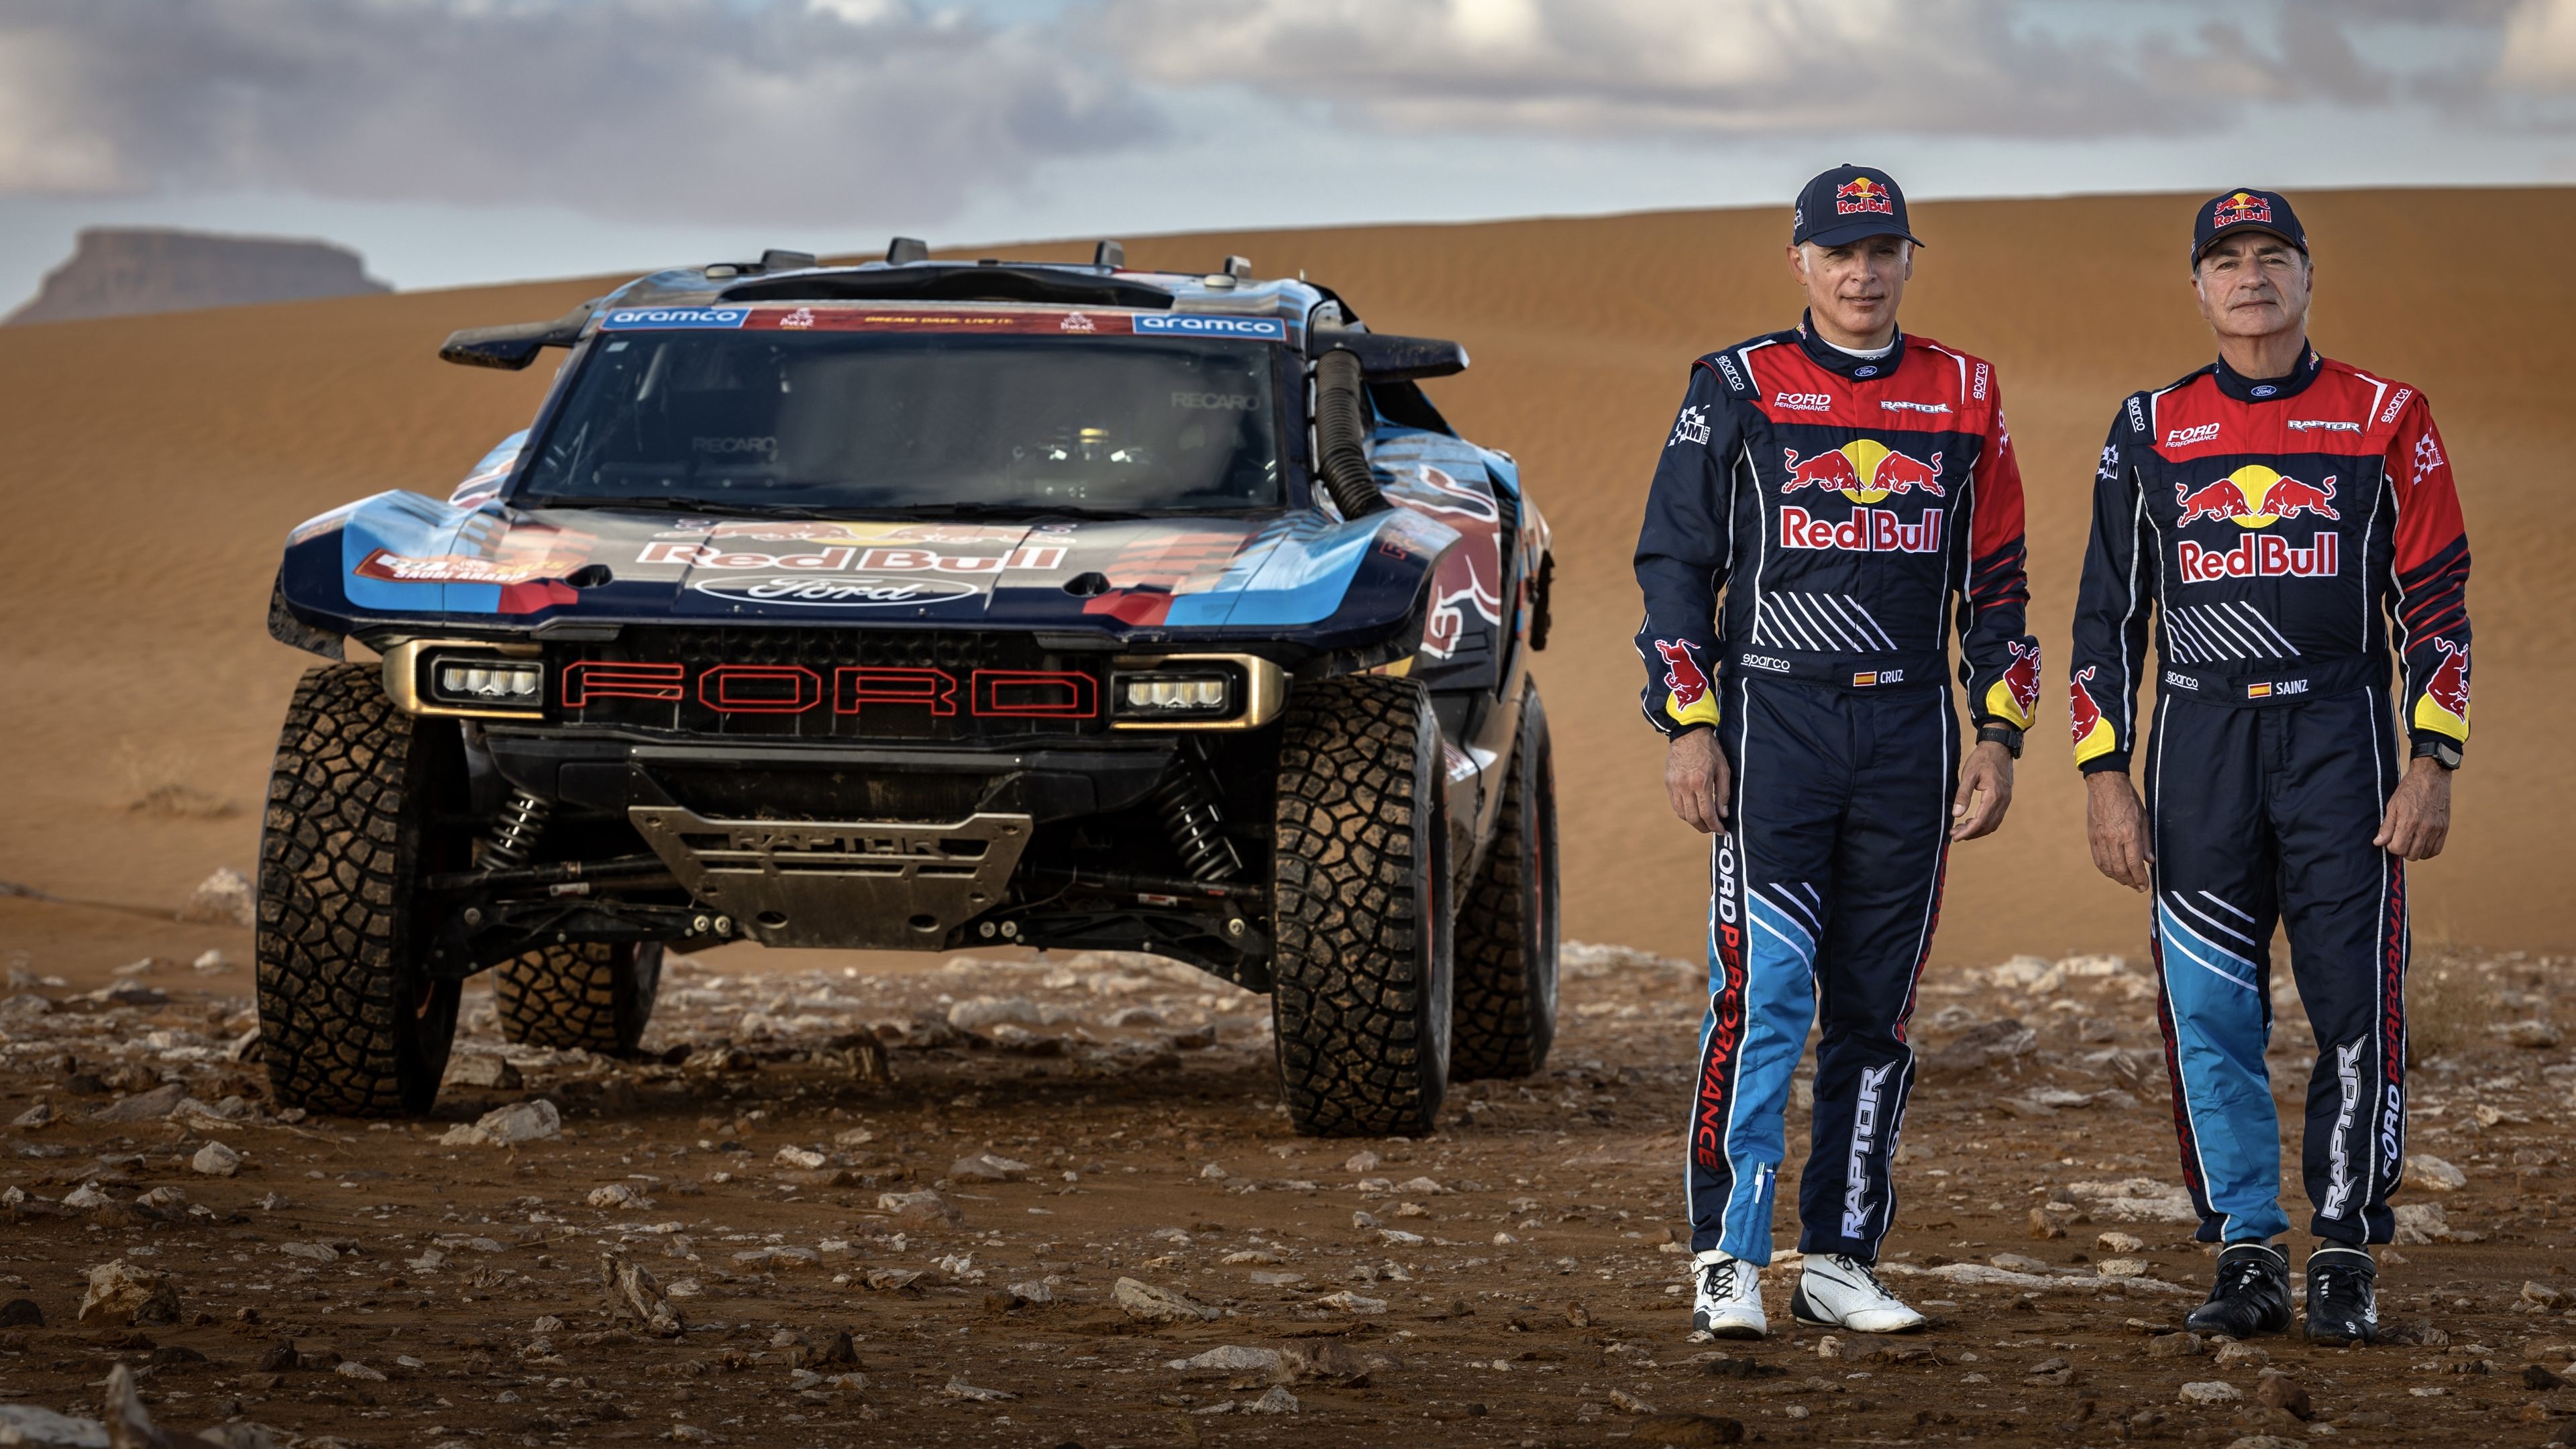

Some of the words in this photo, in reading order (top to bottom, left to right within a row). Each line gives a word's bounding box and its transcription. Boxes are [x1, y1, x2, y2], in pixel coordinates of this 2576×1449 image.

[1837, 197, 1867, 215] Red
[1868, 198, 1893, 215] Bull
[2214, 209, 2242, 229] Red
[2243, 209, 2271, 223] Bull
[613, 310, 737, 323] aramco
[1142, 317, 1276, 333] aramco
[1716, 355, 1744, 391] sparco
[1973, 363, 1988, 400] sparco
[1776, 392, 1831, 406] FORD
[2254, 386, 2274, 396] Ford
[1171, 392, 1260, 411] RECARO
[1774, 401, 1831, 412] PERFORMANCE
[1880, 400, 1953, 413] RAPTOR
[2381, 388, 2412, 424] sparco
[2127, 397, 2145, 433] sparco
[2167, 422, 2220, 442] FORD
[2288, 419, 2363, 437] RAPTOR
[692, 436, 777, 453] RECARO
[2165, 433, 2218, 448] PERFORMANCE
[1780, 505, 1870, 552] Red
[1872, 508, 1944, 553] Bull
[636, 541, 849, 570] Red
[856, 547, 1068, 574] Bull
[2178, 533, 2256, 584] Red
[2258, 532, 2339, 578] Bull
[393, 568, 453, 580] SAUDI
[456, 570, 529, 582] ARABIA
[743, 576, 927, 602] Ford
[1741, 653, 1790, 673] sparco
[1880, 669, 1904, 684] CRUZ
[2165, 671, 2198, 690] sparco
[562, 659, 1097, 716] FORD
[2276, 680, 2308, 696] SAINZ
[729, 833, 950, 859] RAPTOR
[1719, 830, 1737, 924] FORD
[2386, 856, 2402, 1085] PERFORMAN
[2320, 1033, 2368, 1221] RAPTOR
[2381, 1084, 2400, 1179] FORD
[1841, 1059, 1898, 1240] RAPTOR
